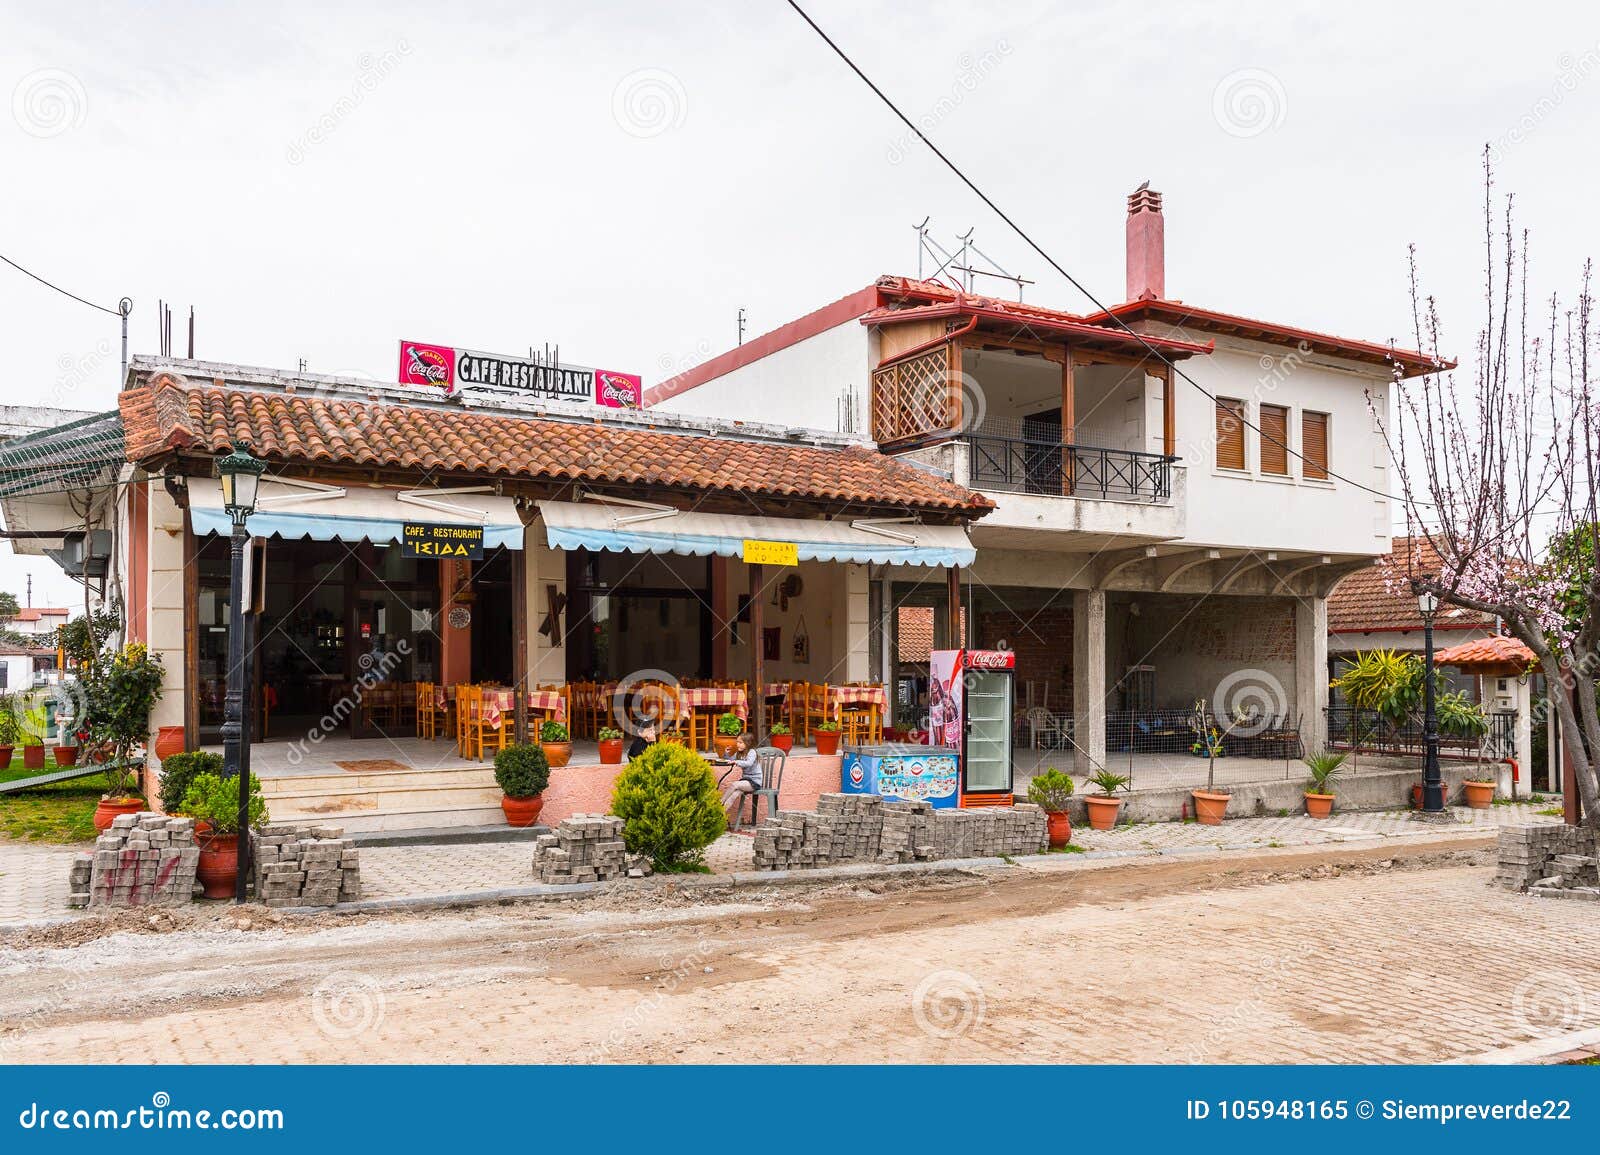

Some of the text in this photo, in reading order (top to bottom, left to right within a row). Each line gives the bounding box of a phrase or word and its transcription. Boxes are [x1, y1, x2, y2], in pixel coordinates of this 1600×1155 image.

[458, 353, 499, 385] CAFE
[501, 361, 592, 396] RESTAURANT
[404, 526, 425, 537] CAFE
[433, 527, 483, 540] RESTAURANT
